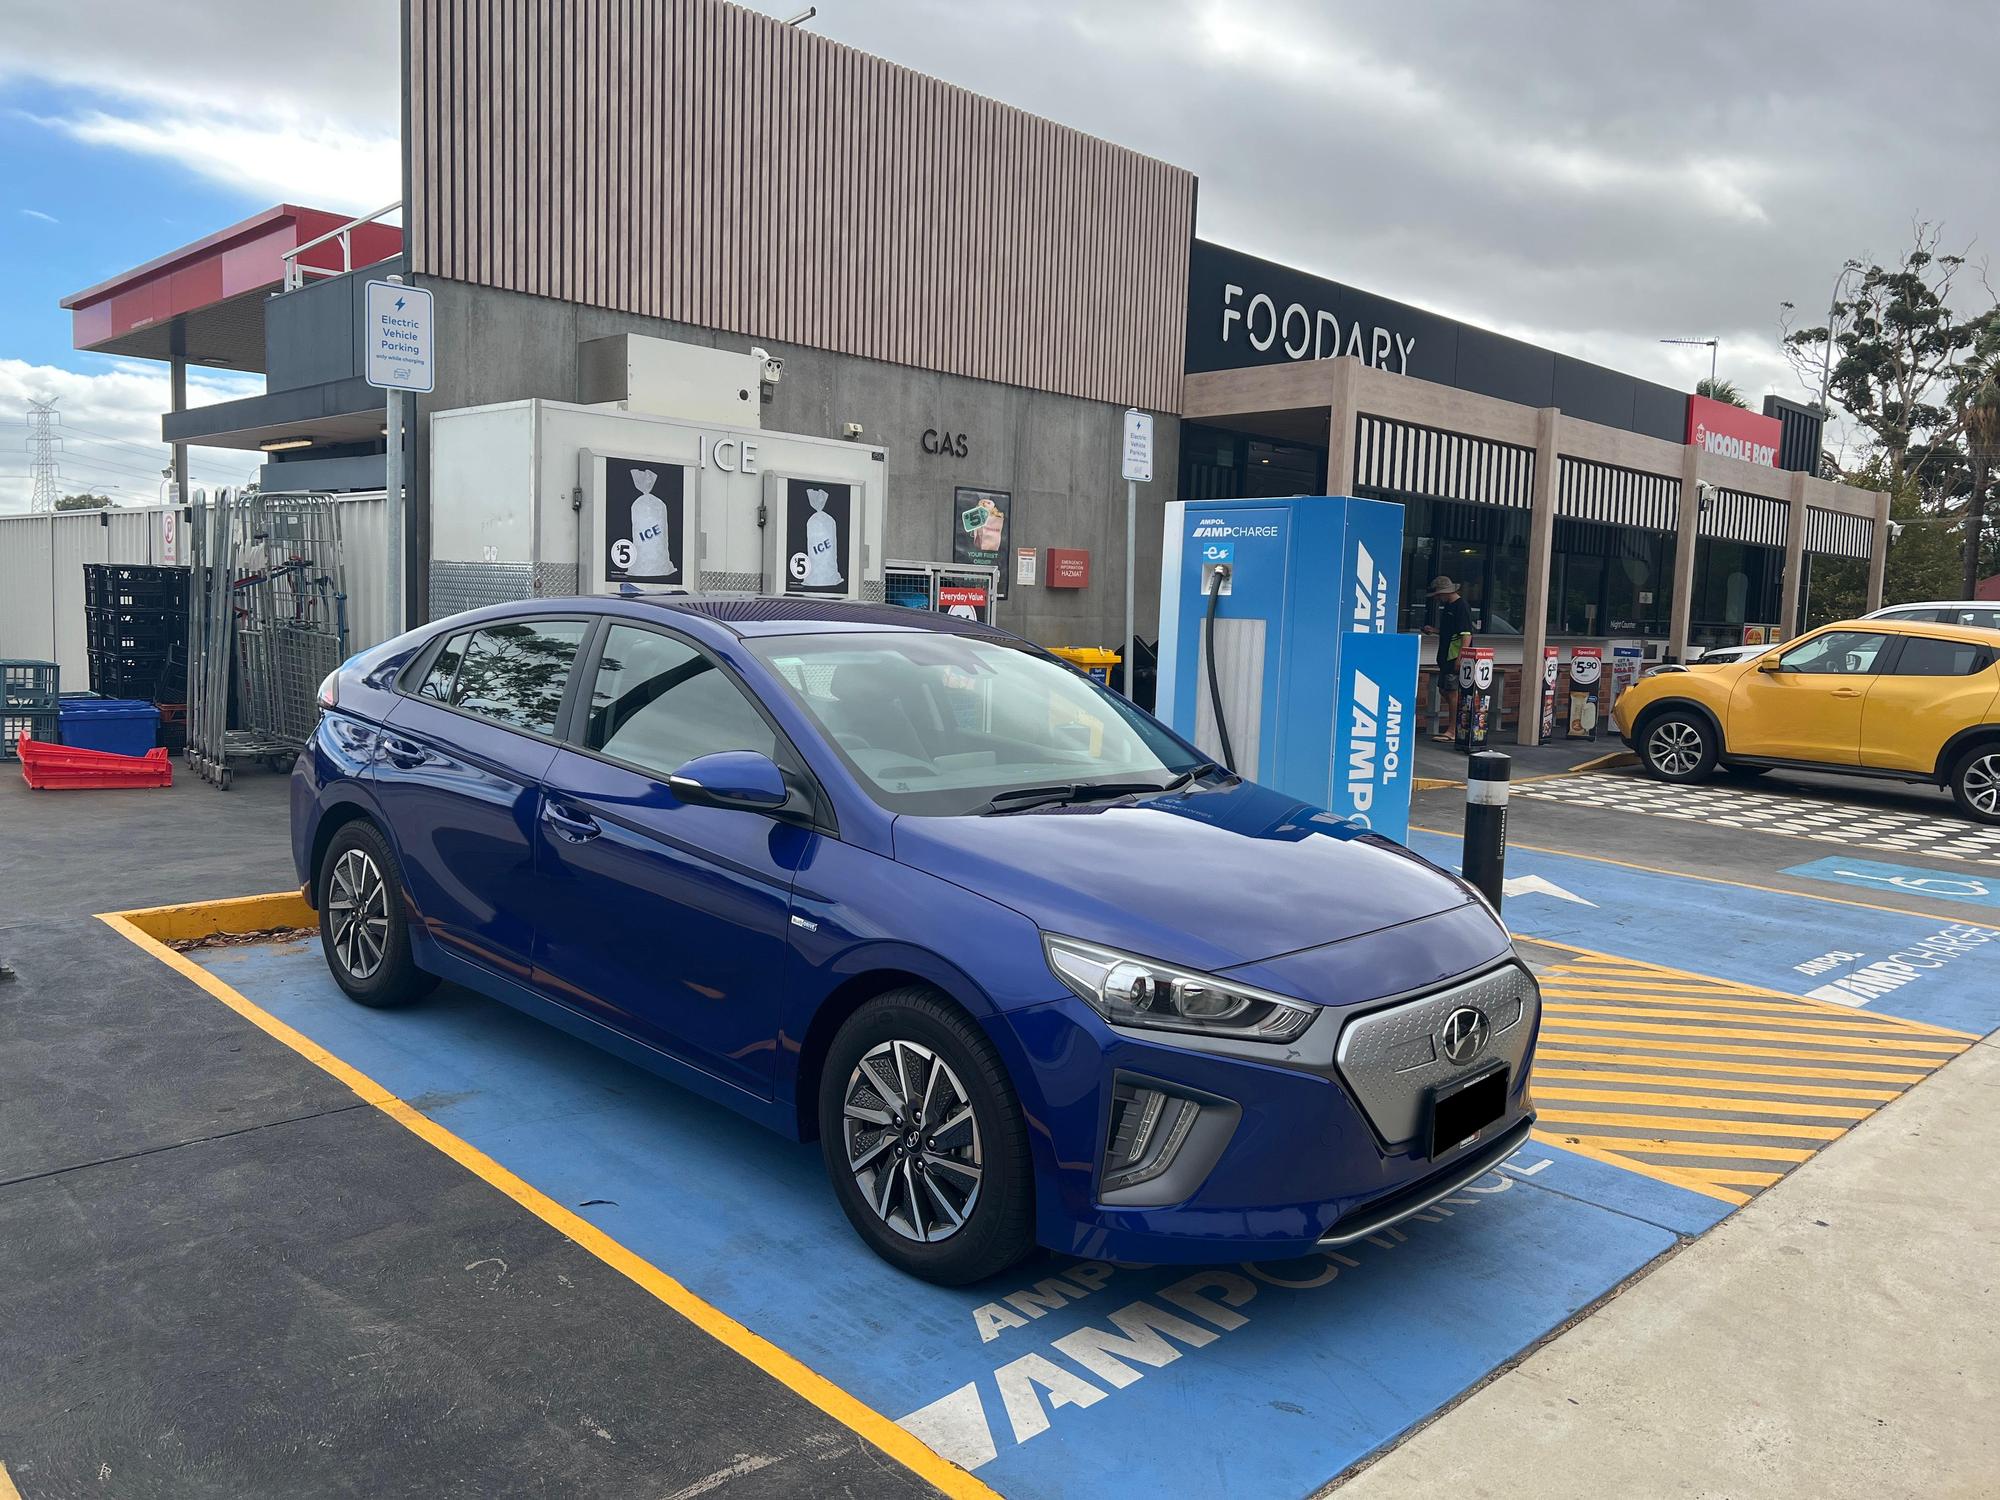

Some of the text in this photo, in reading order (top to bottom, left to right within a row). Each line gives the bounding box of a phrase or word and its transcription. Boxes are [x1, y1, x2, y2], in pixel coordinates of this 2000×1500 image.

[381, 314, 420, 329] Electric
[1223, 283, 1415, 376] FOODARY
[382, 327, 418, 341] Vehicle
[381, 340, 420, 355] Parking
[920, 428, 969, 458] GAS
[1704, 430, 1775, 468] NOODLE BOX
[699, 435, 758, 474] ICE
[639, 524, 661, 542] ICE
[1201, 526, 1279, 538] AMPCHARGE
[812, 539, 832, 555] ICE
[940, 591, 984, 603] Everyday Value
[1382, 694, 1402, 785] AMPOL
[1792, 950, 1865, 977] AMPOL
[1832, 924, 2000, 999] AMPCHARGE
